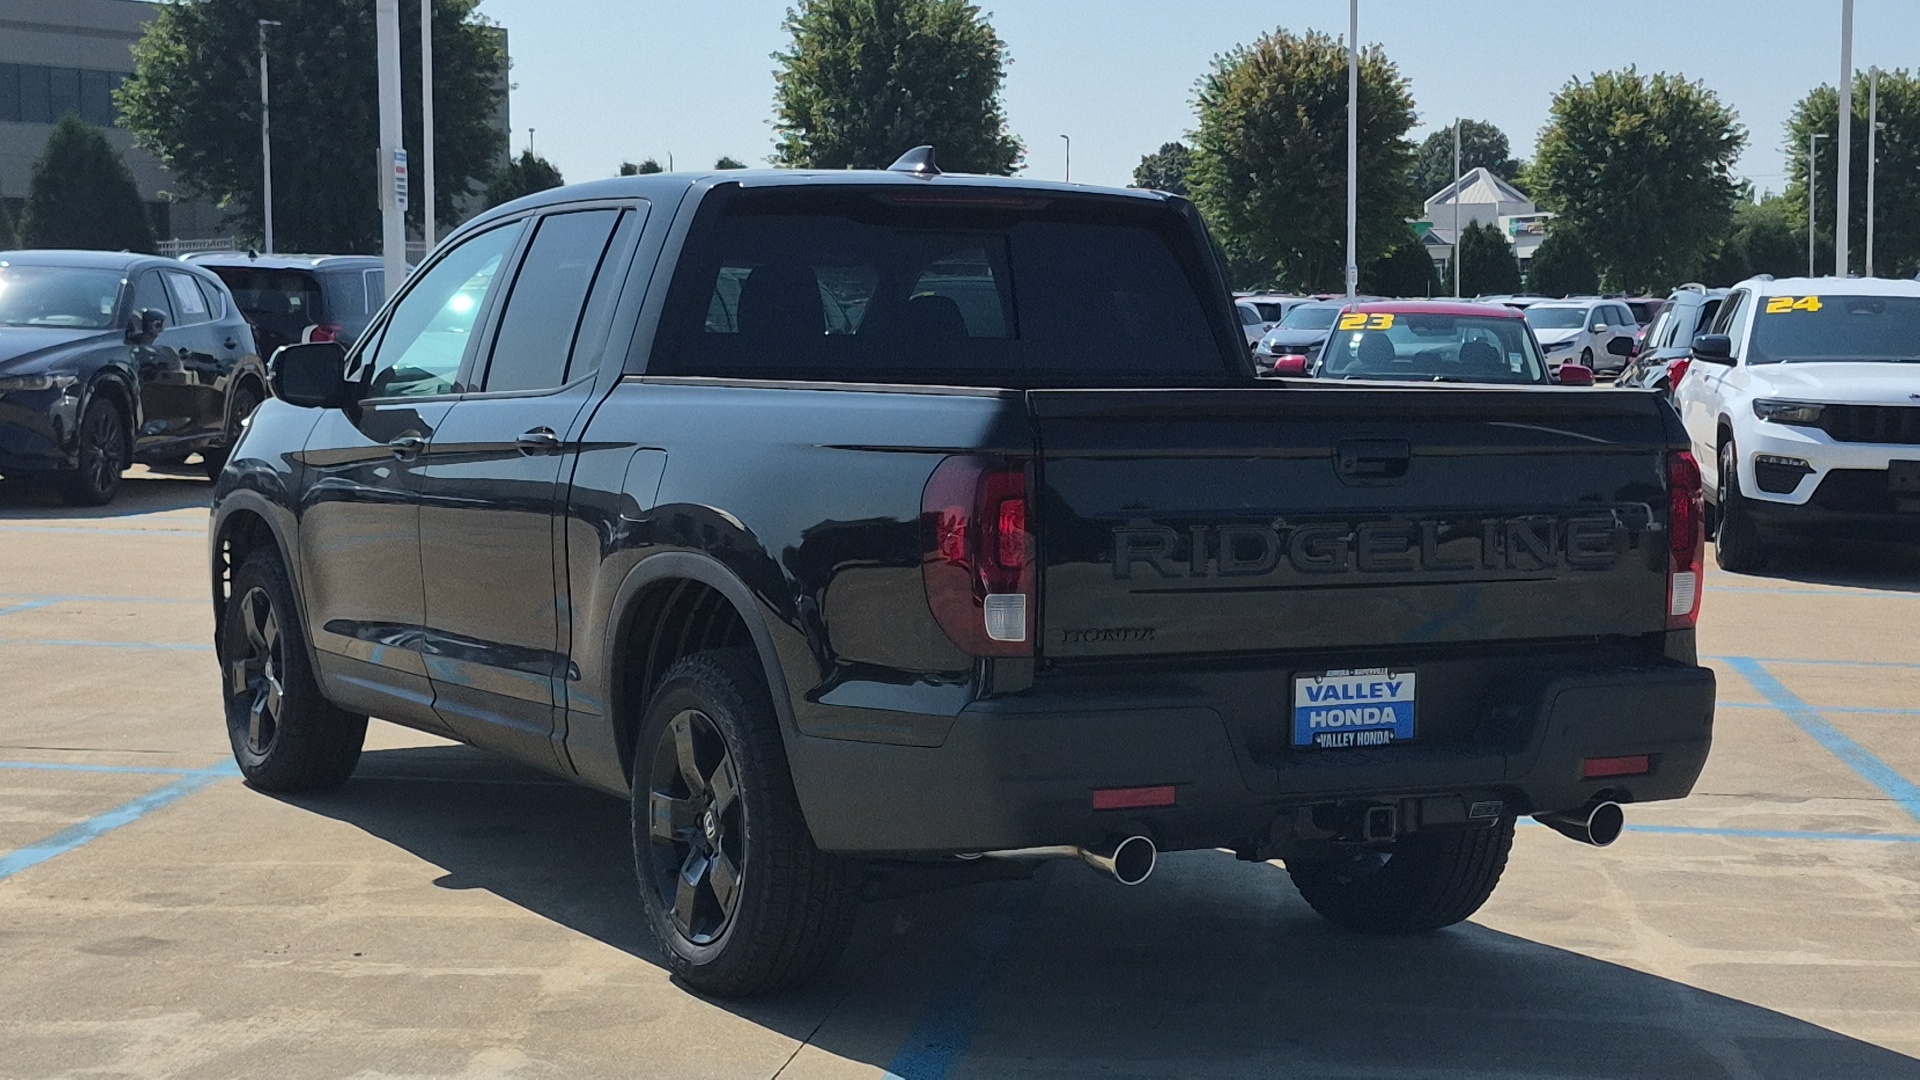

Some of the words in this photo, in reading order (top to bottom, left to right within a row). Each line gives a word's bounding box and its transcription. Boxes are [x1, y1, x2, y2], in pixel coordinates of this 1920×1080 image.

[1765, 296, 1823, 314] 24
[1338, 312, 1395, 331] 23
[1111, 516, 1617, 580] RIDGELINE
[1061, 627, 1156, 643] HONDA
[1305, 681, 1403, 702] VALLEY
[1309, 706, 1397, 728] HONDA
[1320, 732, 1356, 748] VALLEY
[1356, 729, 1390, 747] HONDA
